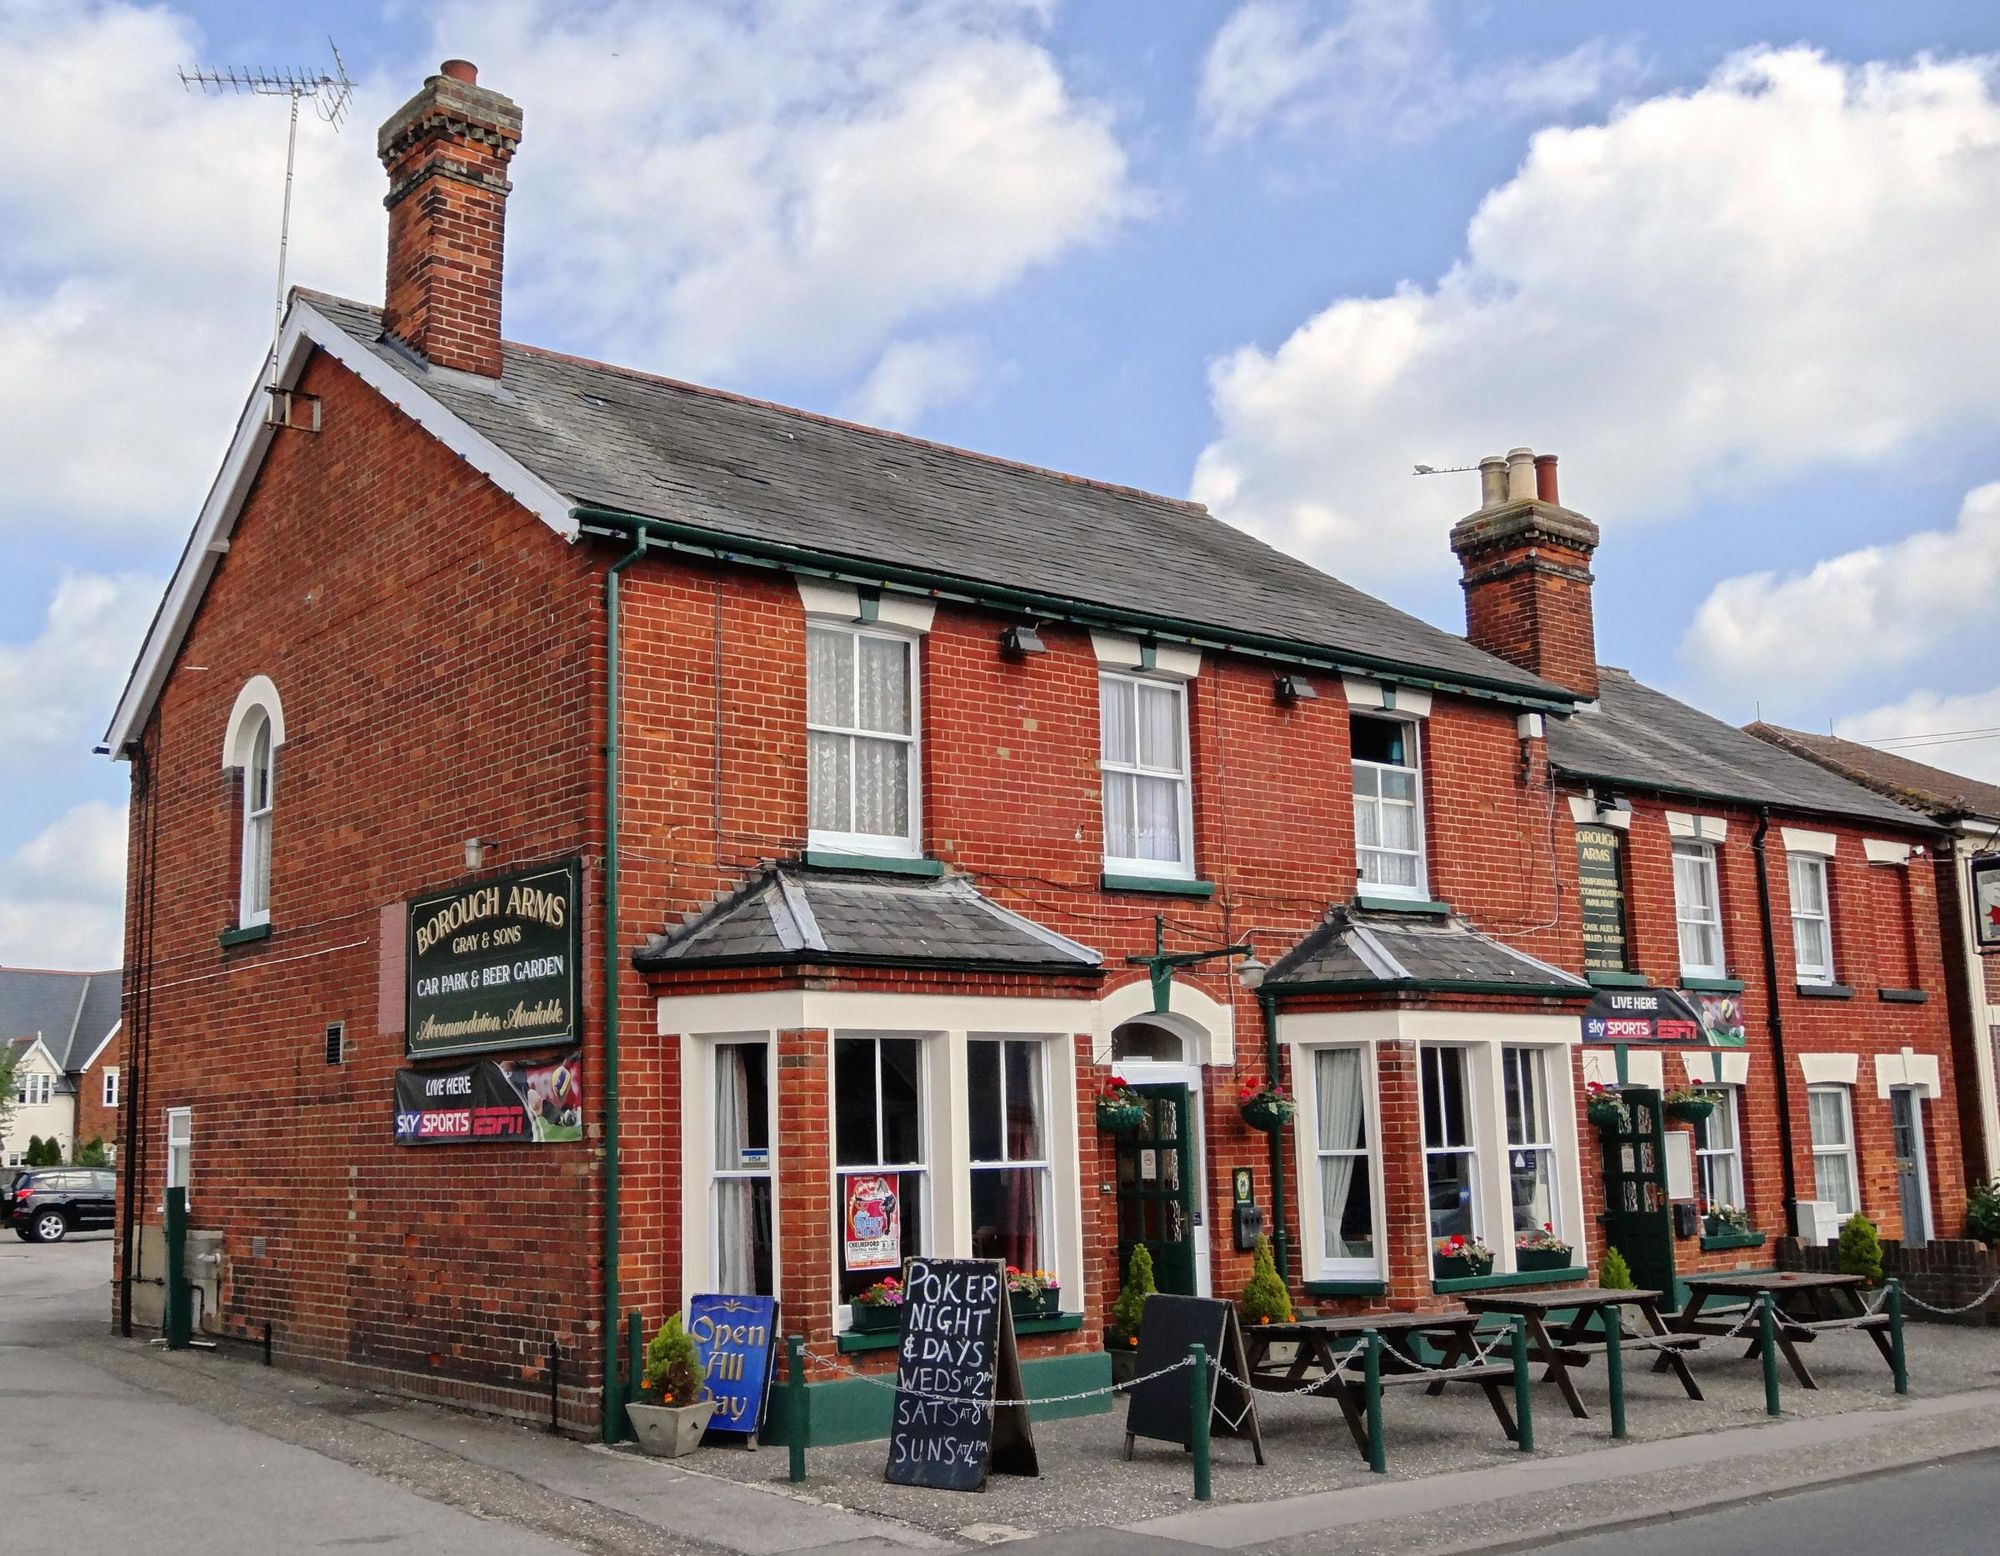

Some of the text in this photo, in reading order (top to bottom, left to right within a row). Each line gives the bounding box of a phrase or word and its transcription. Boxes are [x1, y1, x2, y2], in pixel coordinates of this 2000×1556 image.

[1582, 848, 1611, 862] ARMS
[415, 886, 566, 956] BOROUGH ARMS
[1614, 925, 1620, 934] &
[453, 925, 522, 954] GRAY & SONS
[416, 955, 564, 997] CAR PARK & BEER GARDEN
[1612, 996, 1657, 1010] LIVE HERE
[416, 998, 564, 1041] Accommodation Available
[1588, 1017, 1605, 1037] sky
[1607, 1021, 1650, 1035] SPORTS
[425, 1075, 472, 1097] LIVE HERE
[421, 1112, 469, 1133] SPORTS
[906, 1262, 997, 1304] POKER
[909, 1303, 991, 1336] NIGHT
[692, 1315, 765, 1351] Open
[903, 1334, 984, 1367] & DAYS
[704, 1351, 744, 1380] All
[963, 1376, 974, 1386] AT
[960, 1408, 971, 1420] AT
[956, 1443, 967, 1455] AT
